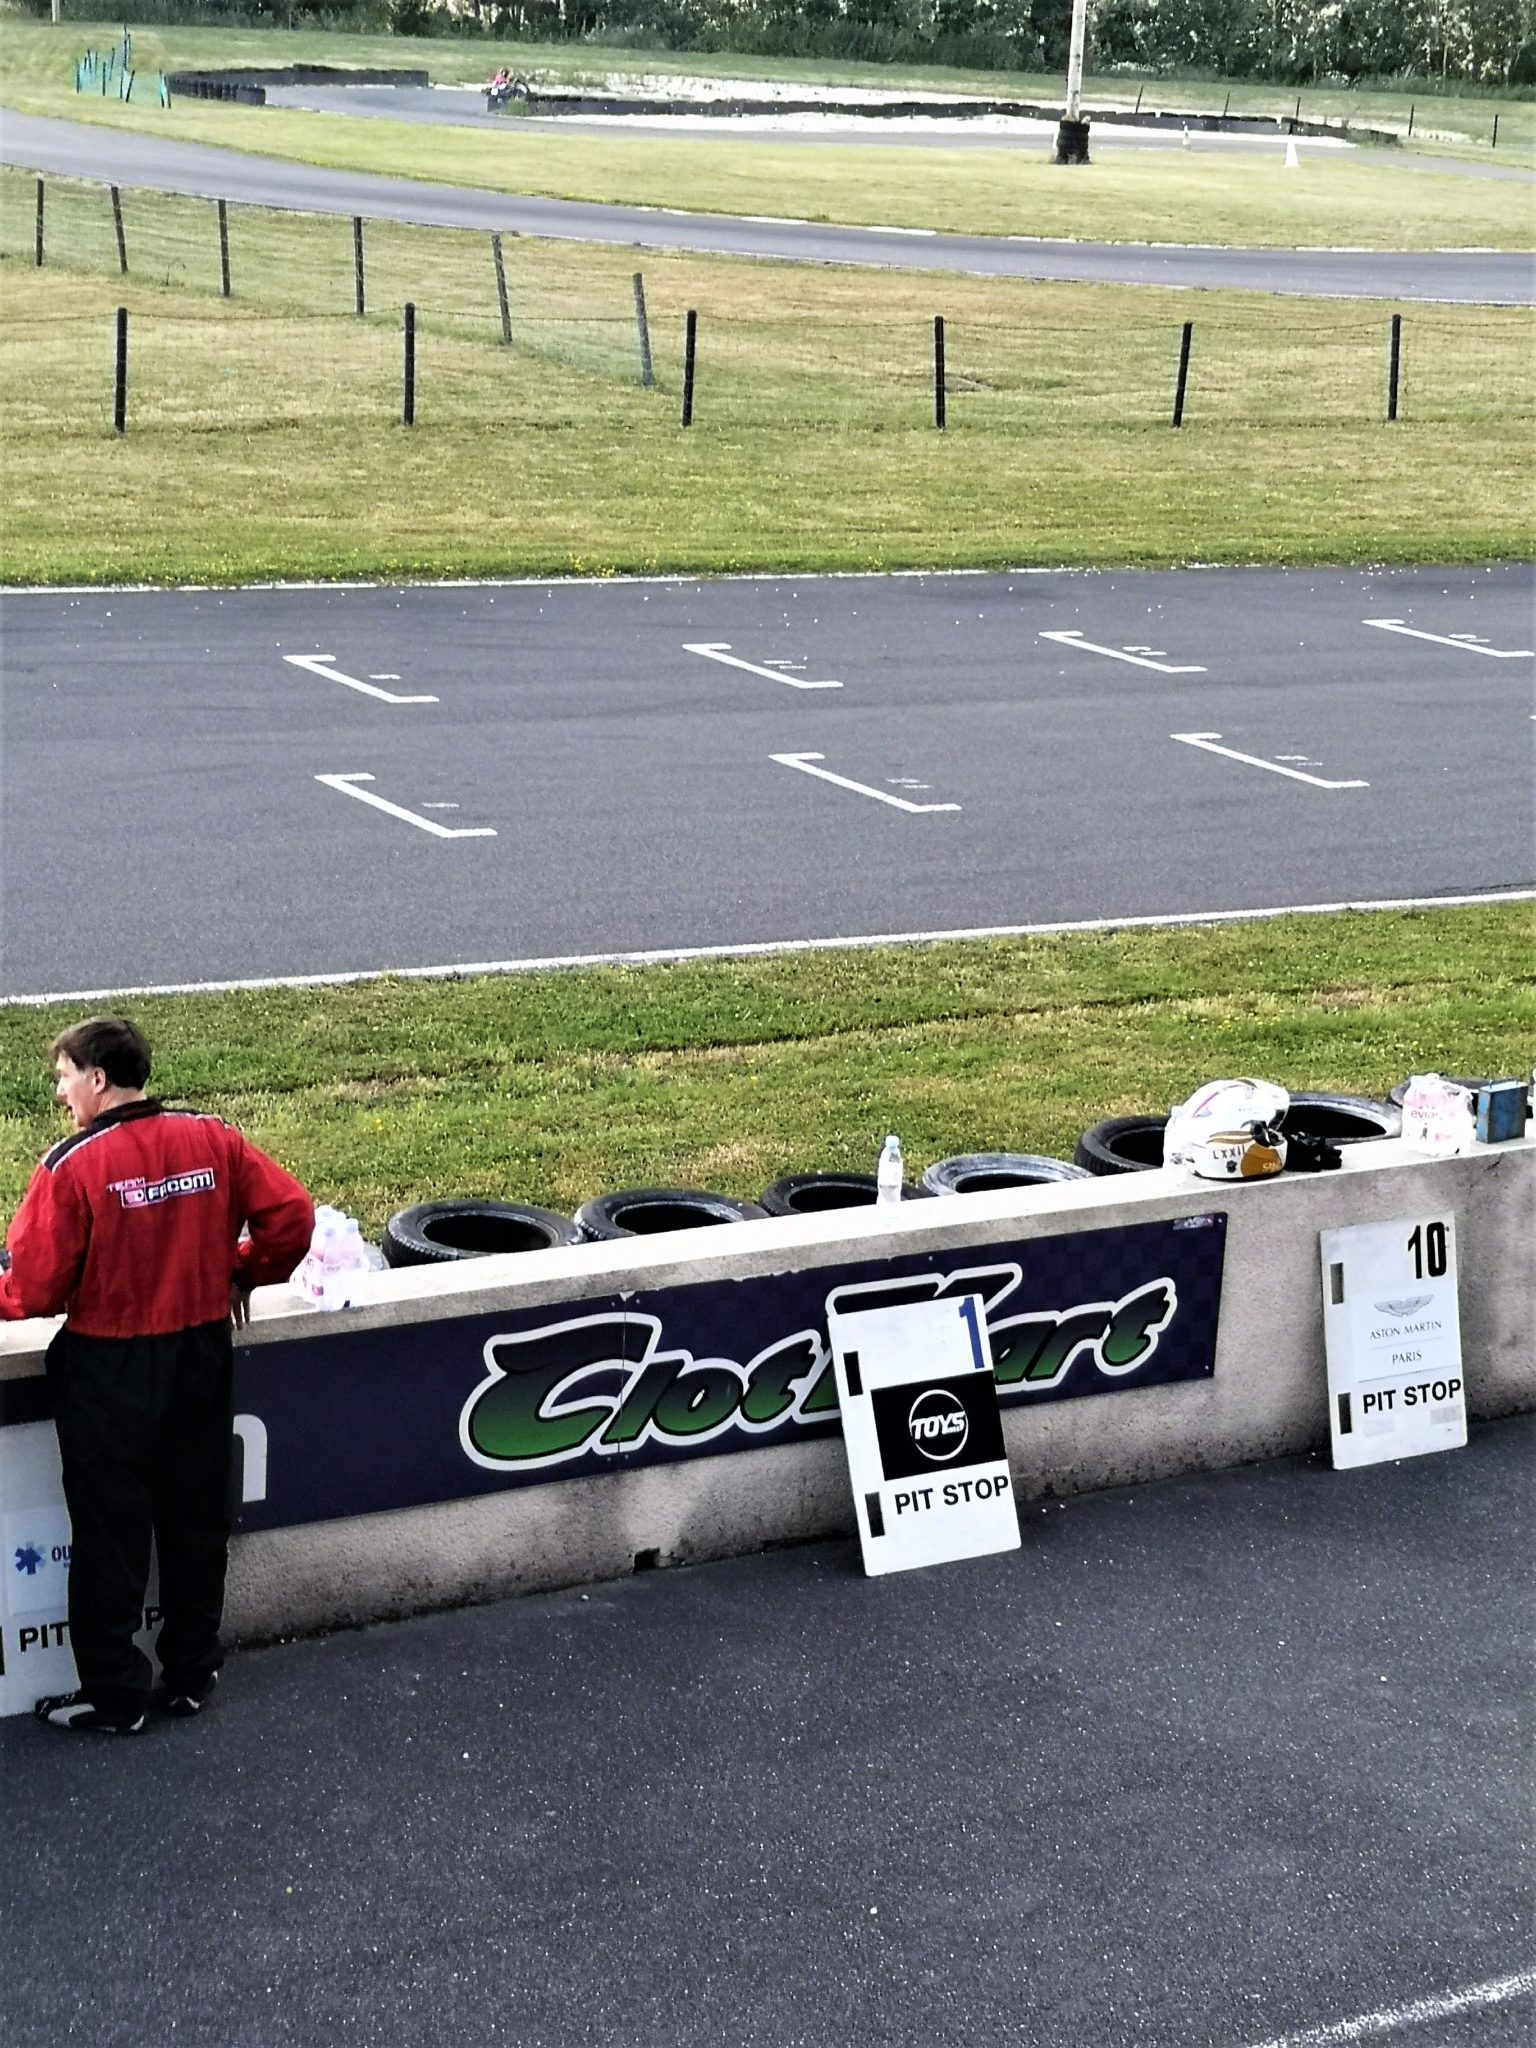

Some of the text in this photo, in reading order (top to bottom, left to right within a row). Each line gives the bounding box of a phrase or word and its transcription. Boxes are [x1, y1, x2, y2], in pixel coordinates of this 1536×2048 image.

[1407, 1221, 1447, 1280] 10
[958, 1296, 986, 1370] 1
[1369, 1319, 1443, 1341] ASTON MARTIN
[1391, 1350, 1423, 1365] PARIS
[1362, 1378, 1462, 1414] PIT STOP
[910, 1410, 967, 1440] TOYS
[895, 1474, 1010, 1516] PIT STOP
[18, 1620, 70, 1654] PIT
